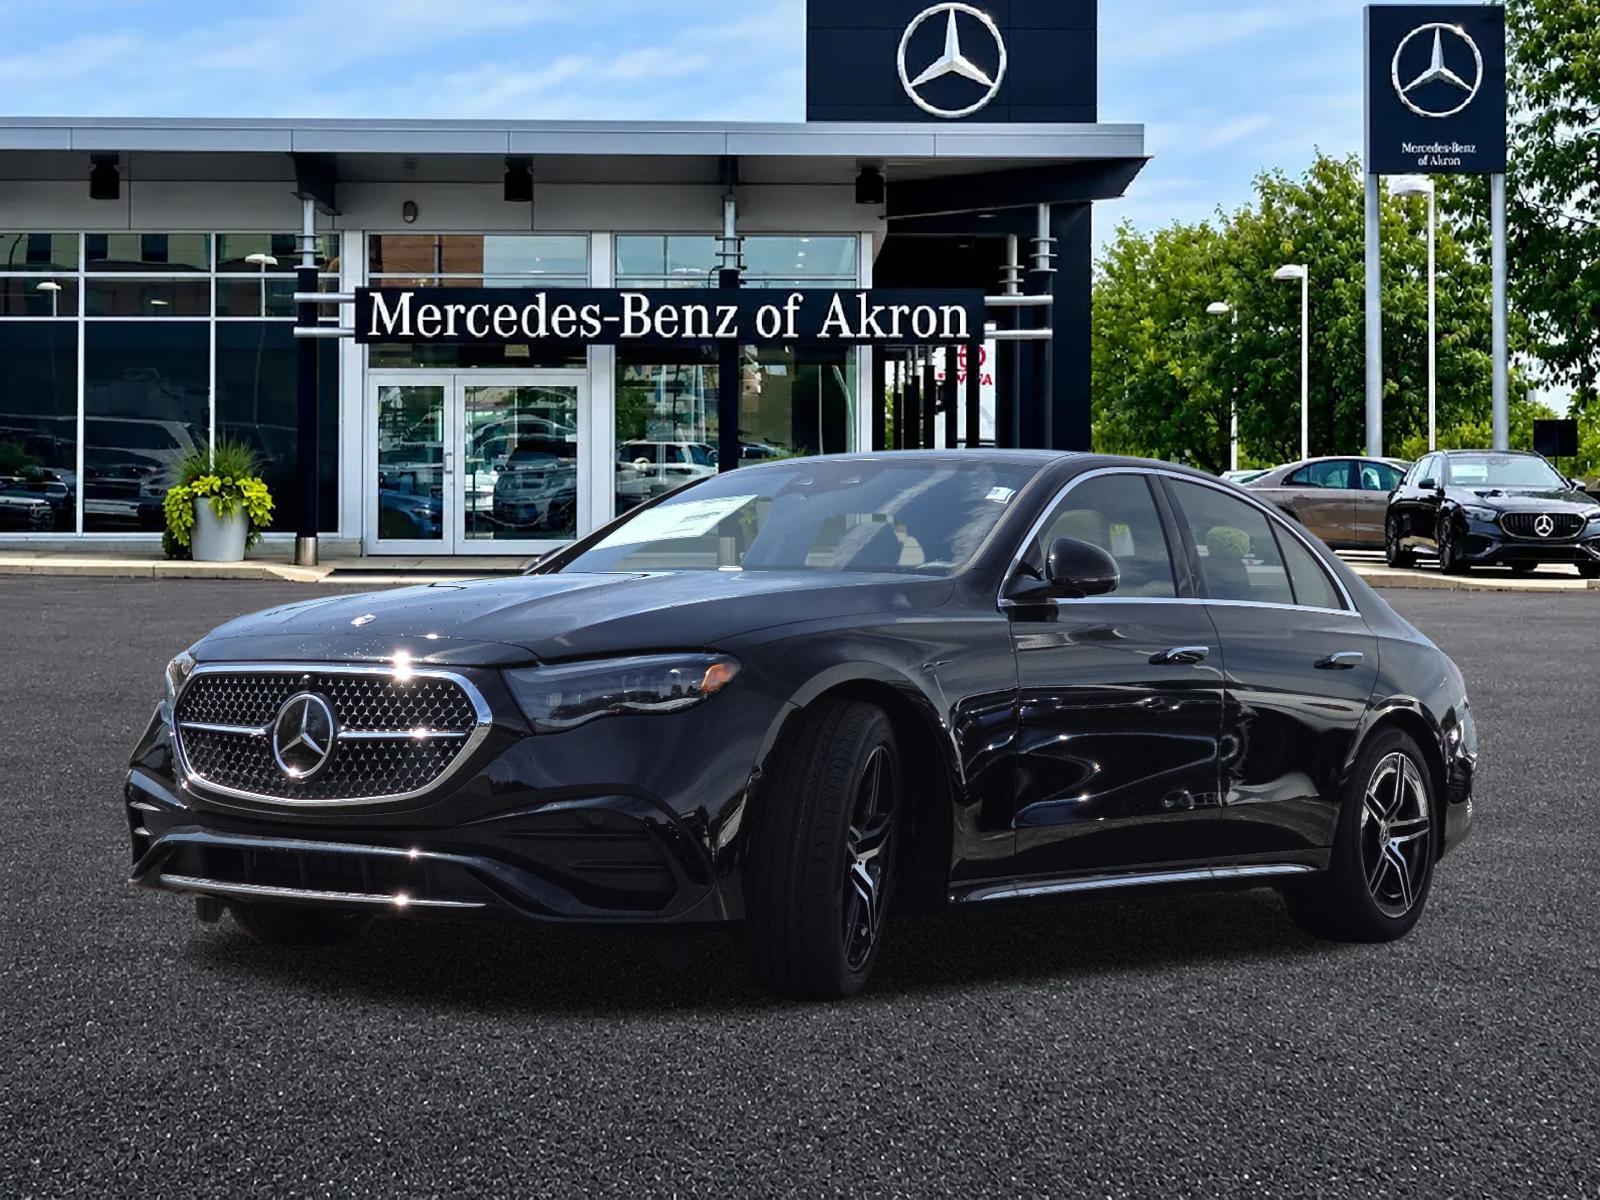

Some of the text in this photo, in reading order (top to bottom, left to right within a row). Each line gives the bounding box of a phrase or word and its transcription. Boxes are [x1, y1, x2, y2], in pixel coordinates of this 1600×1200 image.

[1401, 142, 1477, 154] Mercedes-Benz
[1417, 155, 1461, 166] of Akron
[367, 291, 971, 339] Mercedes-Benz of Akron
